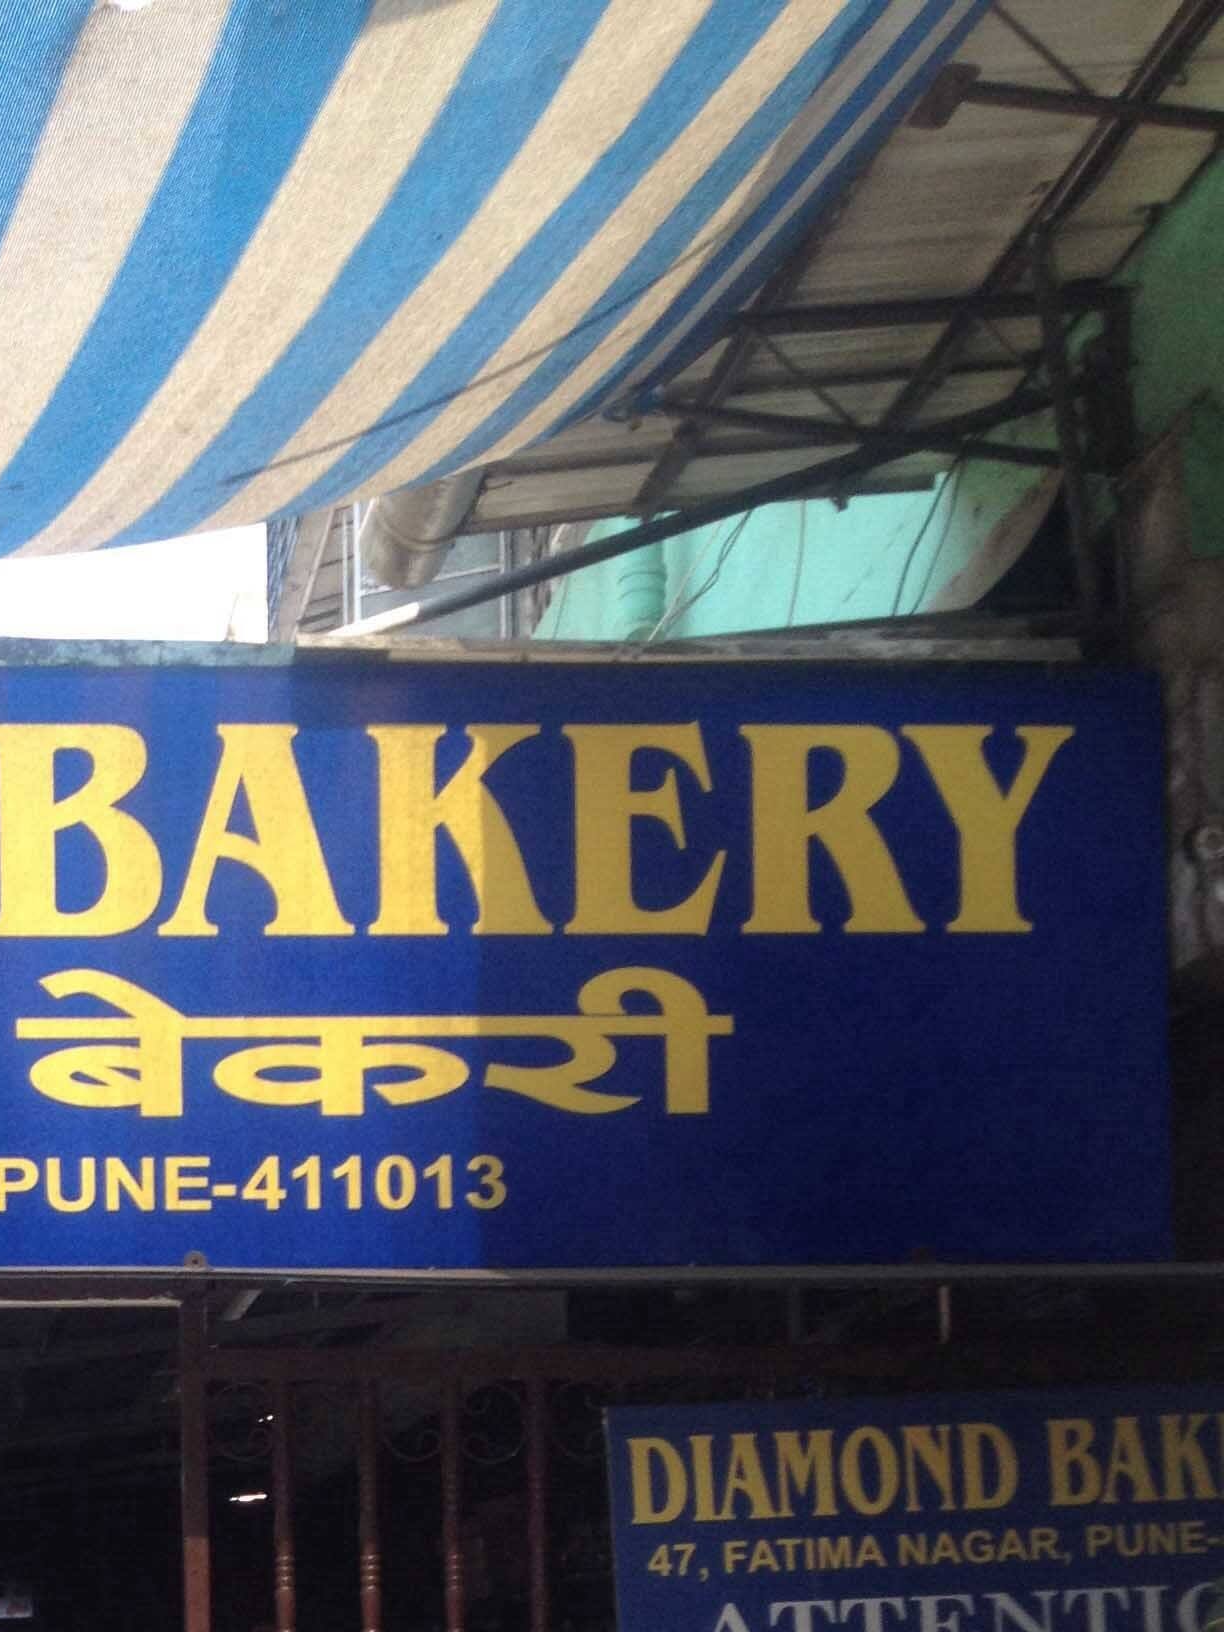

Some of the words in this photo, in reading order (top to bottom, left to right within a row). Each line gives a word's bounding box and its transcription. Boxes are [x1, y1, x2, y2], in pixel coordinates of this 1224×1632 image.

[15, 966, 735, 1117] बेकरी
[627, 1422, 1018, 1525] DIAMOND
[1047, 1413, 1224, 1507] BAK
[648, 1541, 710, 1582] 47,
[723, 1535, 885, 1574] FATIMA
[898, 1527, 1073, 1567] NAGAR,
